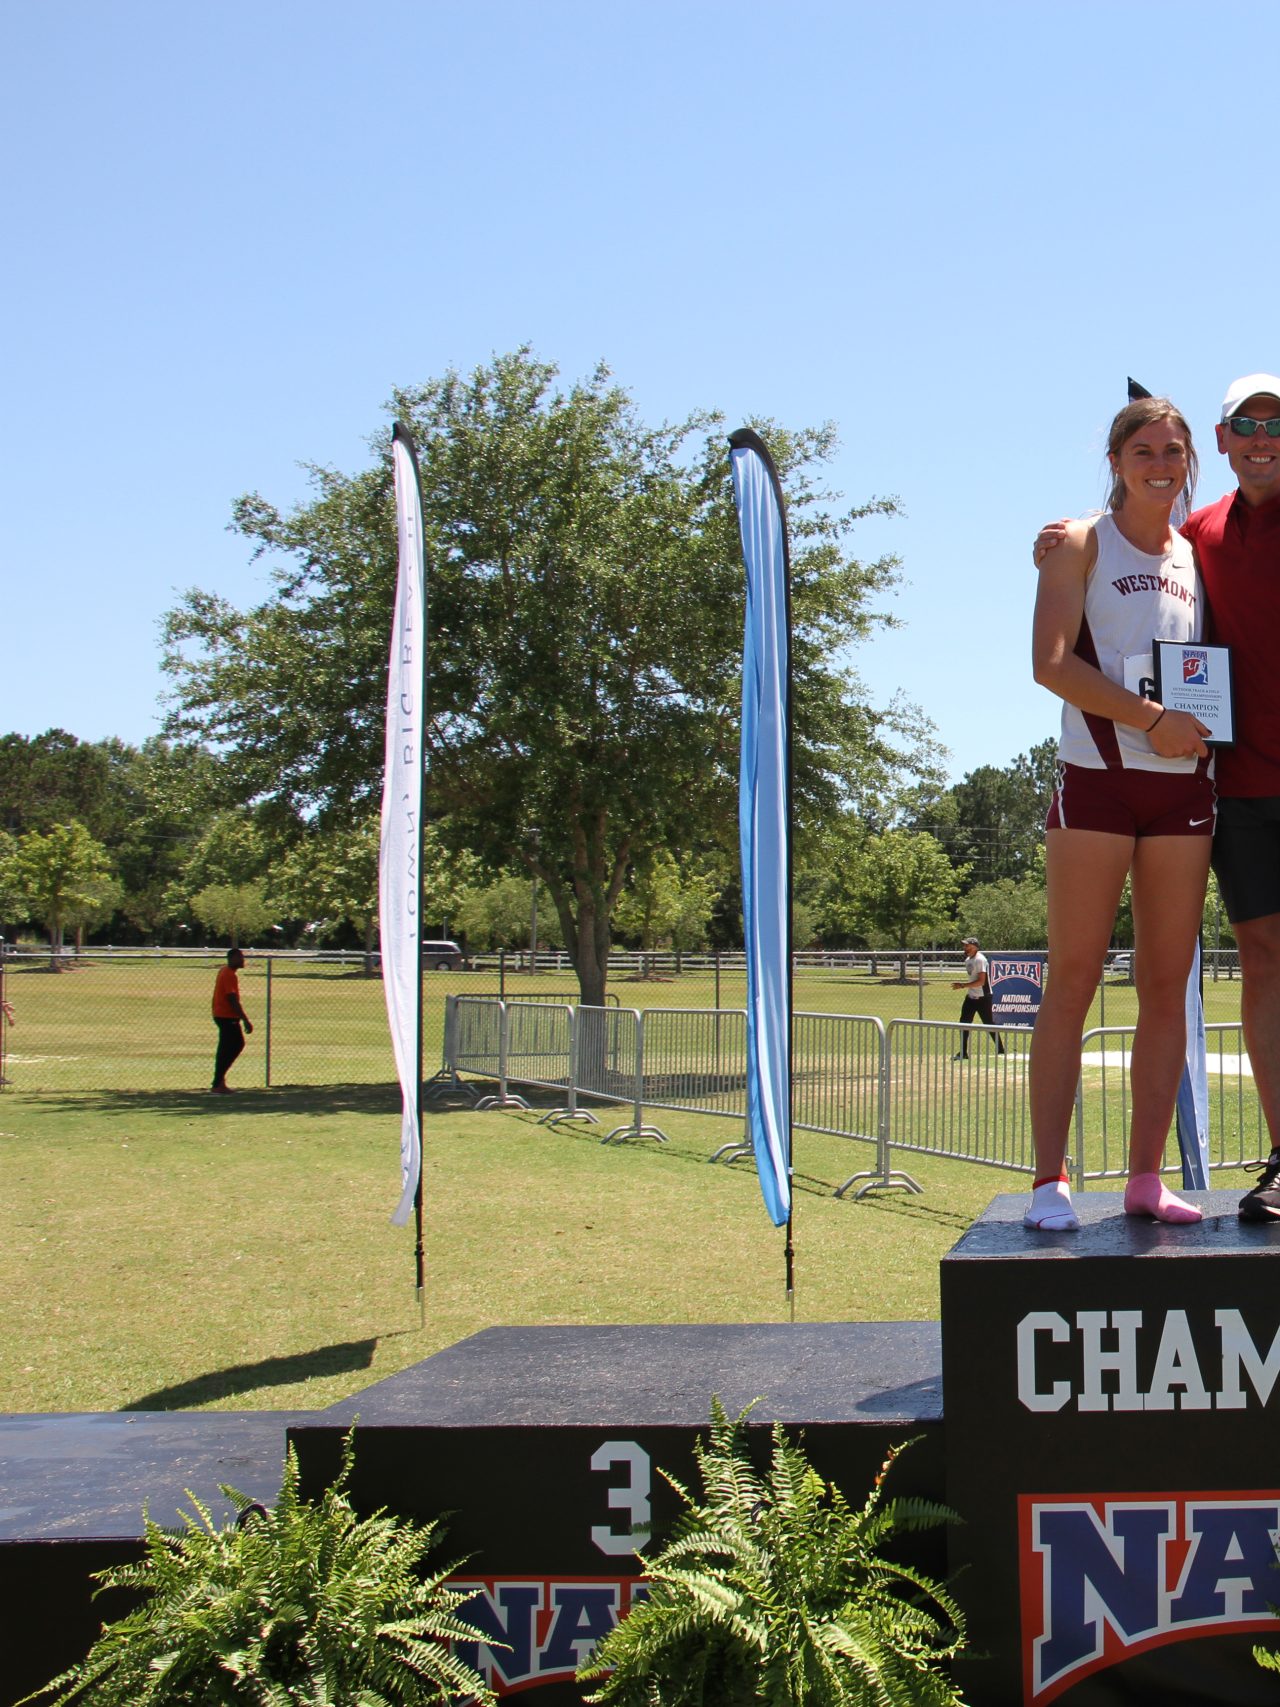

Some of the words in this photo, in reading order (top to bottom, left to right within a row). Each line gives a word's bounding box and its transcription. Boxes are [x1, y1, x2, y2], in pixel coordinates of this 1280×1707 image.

[1111, 573, 1197, 608] WESTMONT
[1174, 702, 1220, 711] CHAMPION
[1192, 711, 1219, 719] ATHLON
[994, 963, 1038, 981] NAIA
[1001, 994, 1032, 1003] NATIONAL
[591, 1441, 651, 1555] 3
